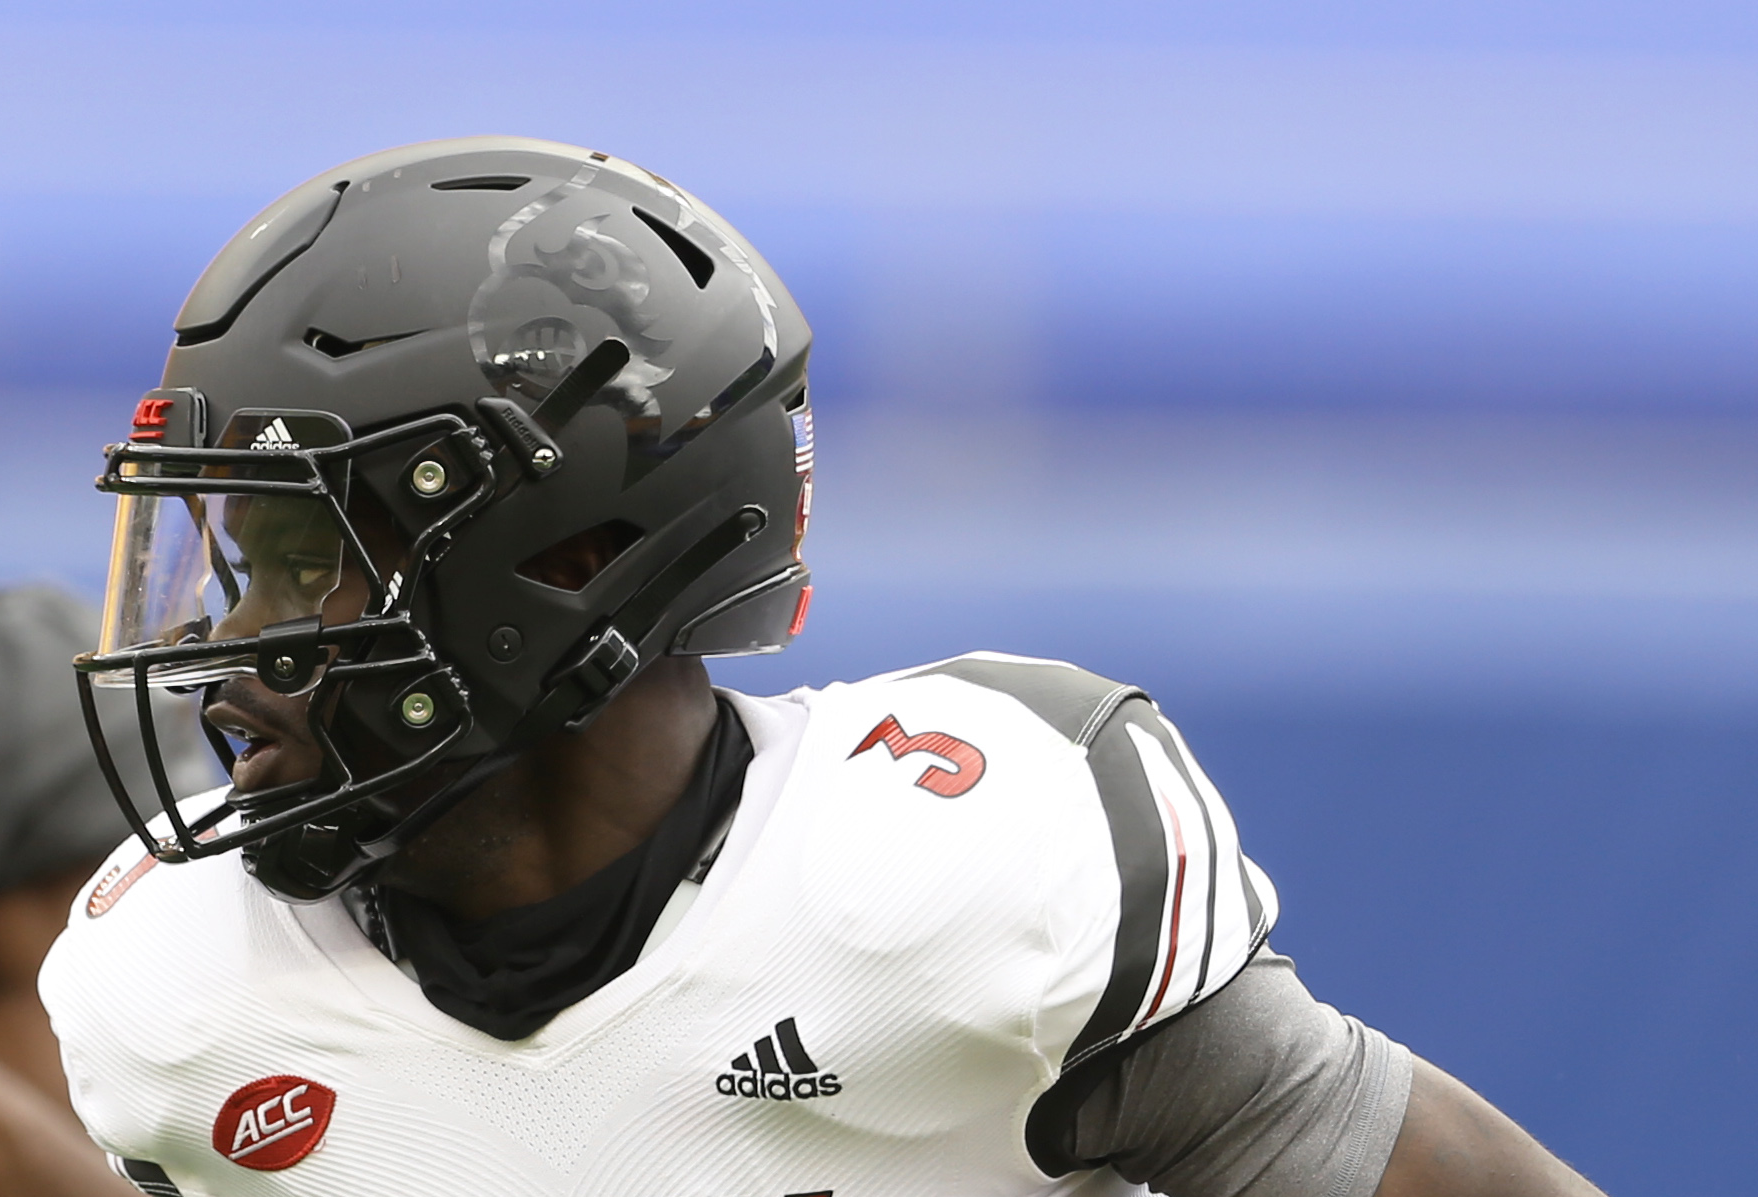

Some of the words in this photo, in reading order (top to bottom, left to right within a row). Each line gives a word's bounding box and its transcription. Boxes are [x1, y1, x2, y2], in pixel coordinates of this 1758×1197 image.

[846, 713, 987, 799] 3
[231, 1083, 312, 1151] ACC
[715, 1069, 842, 1101] adidas
